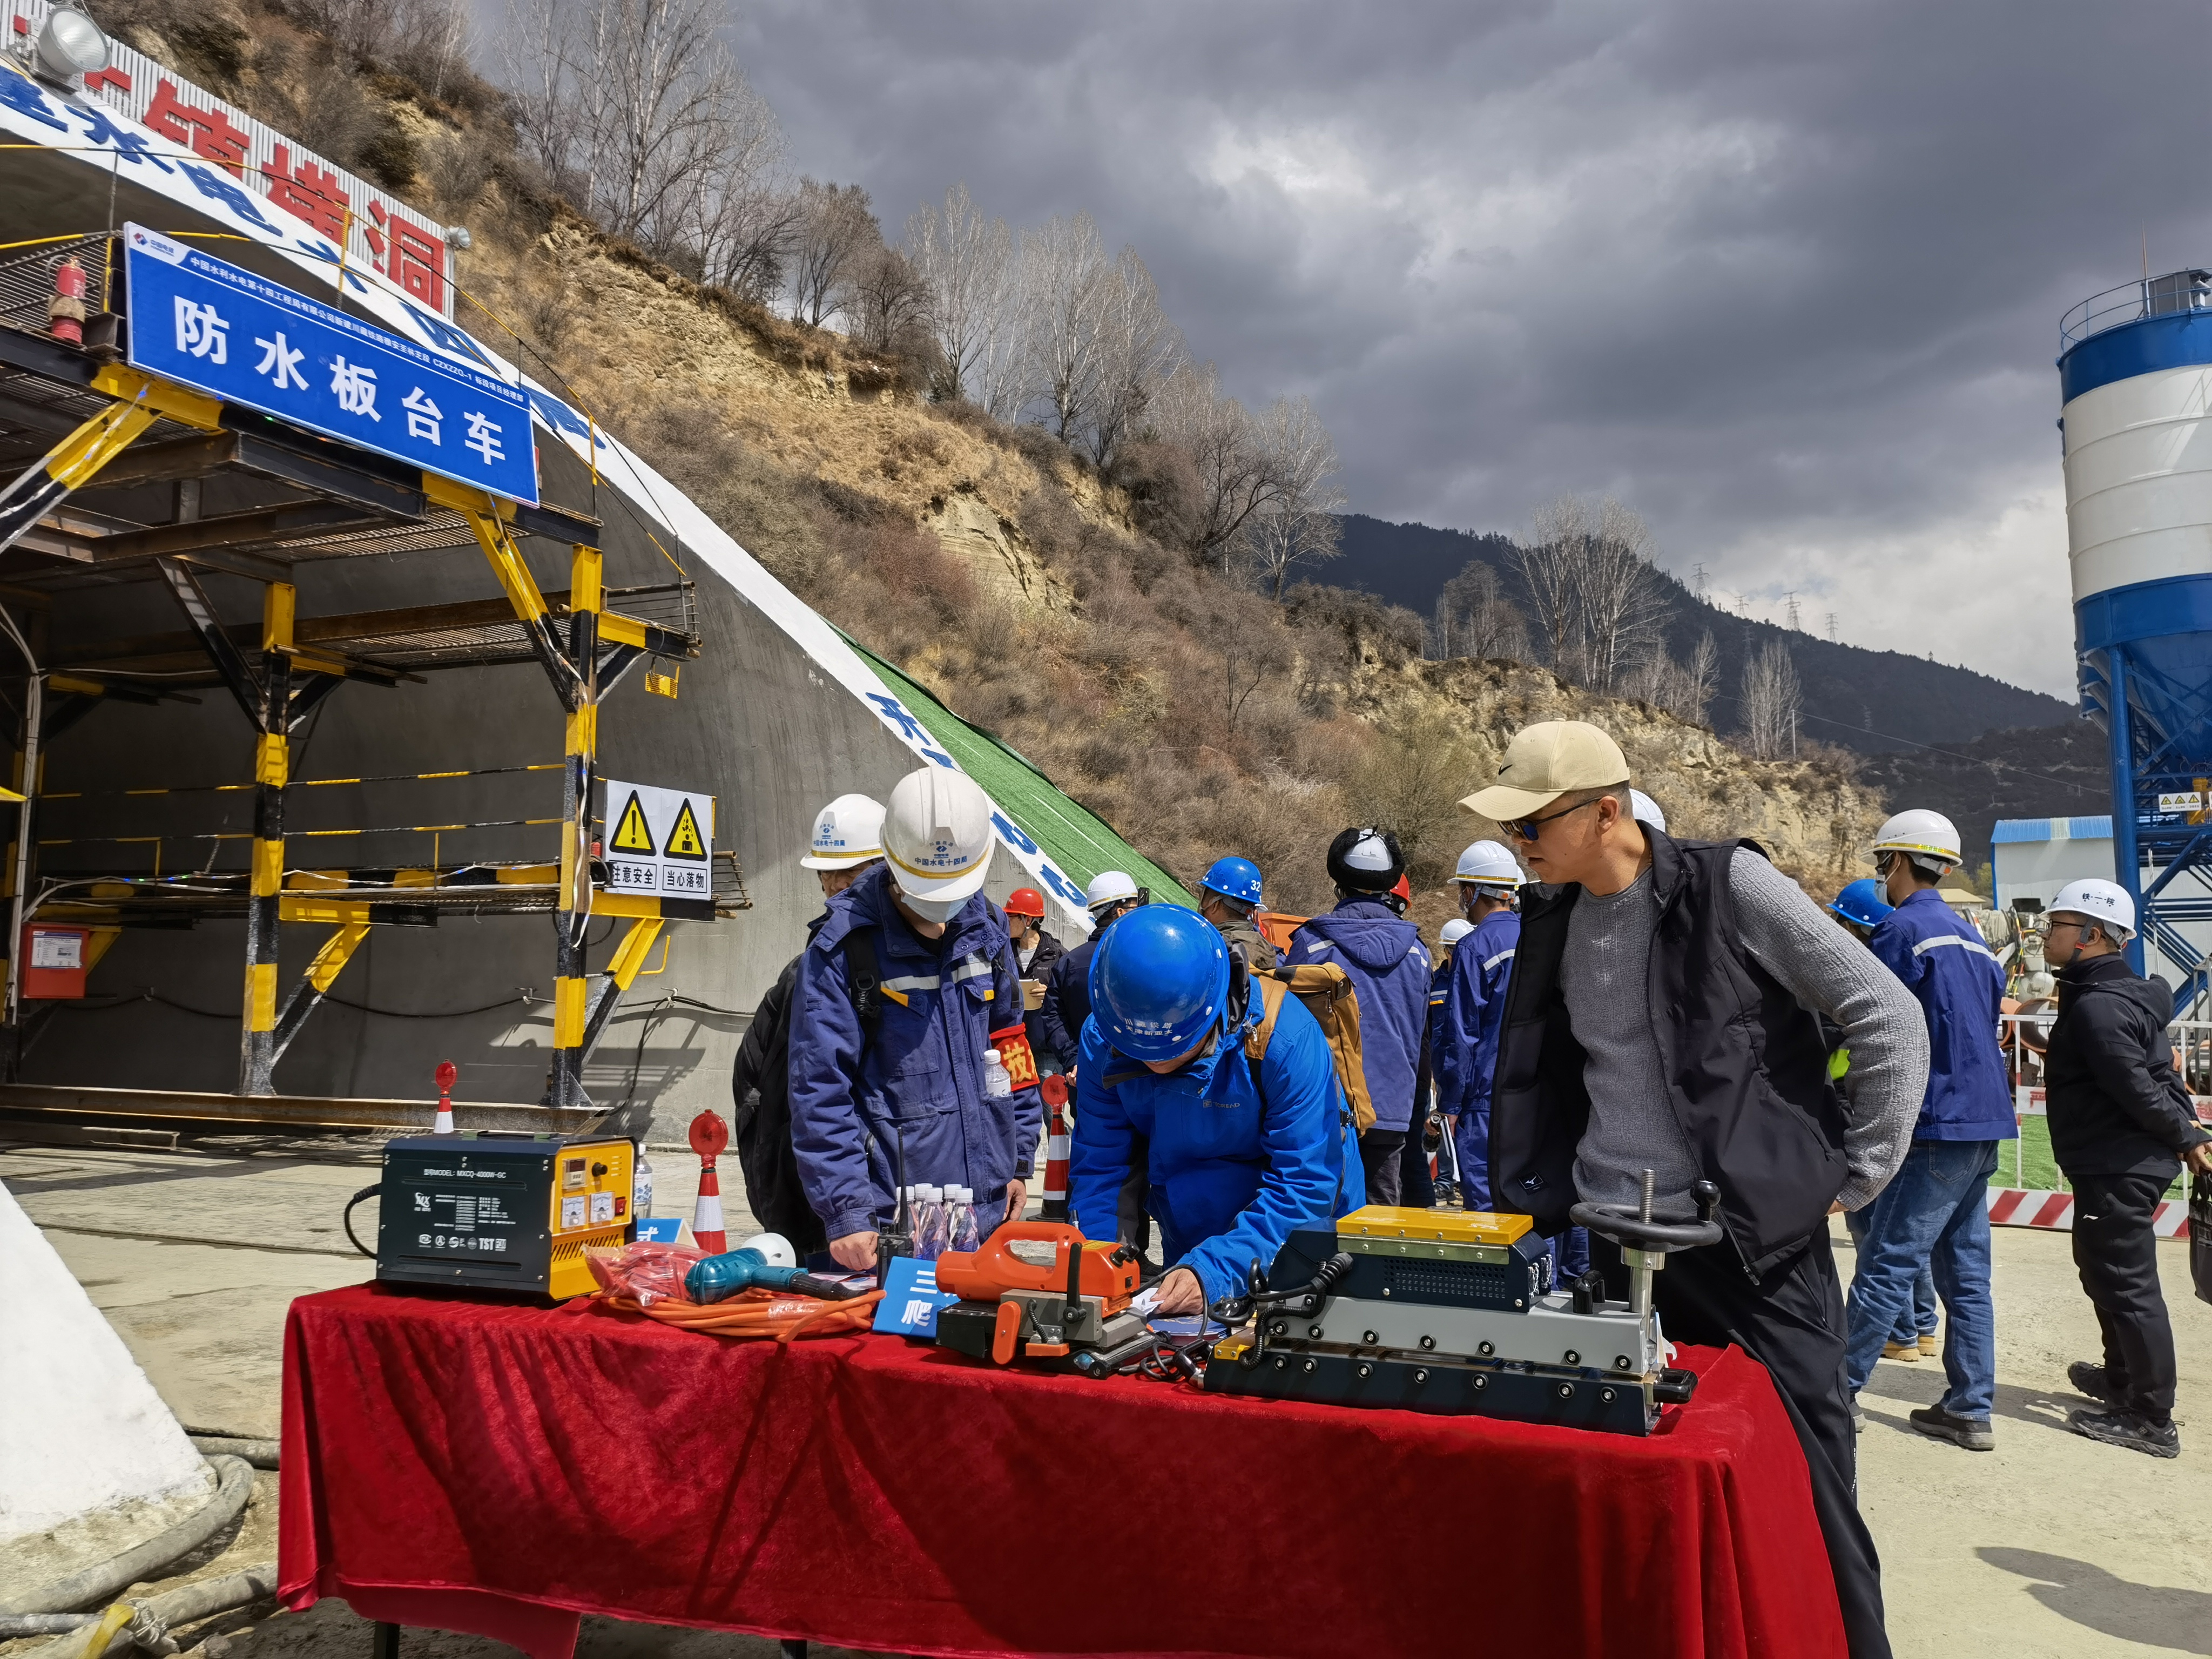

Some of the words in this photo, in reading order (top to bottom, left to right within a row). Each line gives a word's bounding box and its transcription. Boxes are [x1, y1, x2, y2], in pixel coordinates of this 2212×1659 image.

[14, 15, 444, 313] 镇横洞
[174, 294, 506, 466] 防水板台车
[475, 375, 524, 403] 标段项目经理部
[914, 855, 968, 867] 中国水电十四局
[613, 866, 654, 886] 注意安全
[666, 870, 705, 889] 当心落物
[1251, 879, 1260, 893] 32
[1003, 1041, 1038, 1084] 技
[478, 1237, 495, 1250] TST
